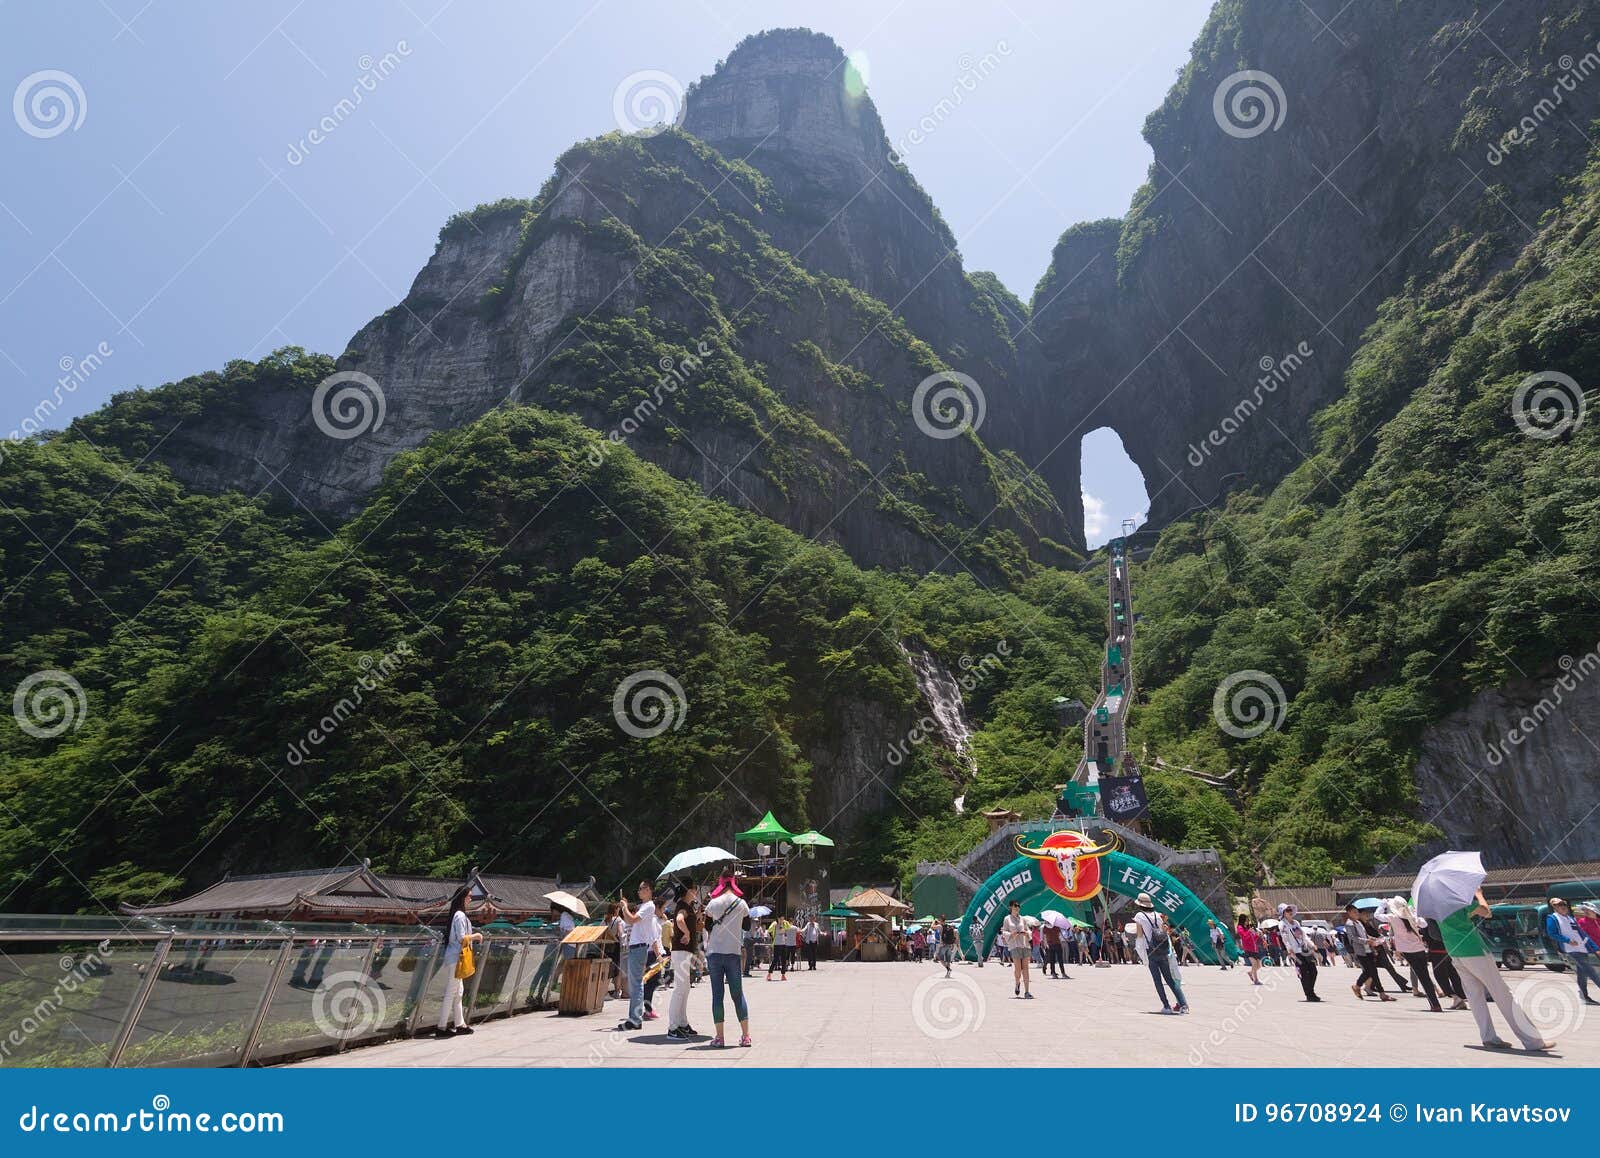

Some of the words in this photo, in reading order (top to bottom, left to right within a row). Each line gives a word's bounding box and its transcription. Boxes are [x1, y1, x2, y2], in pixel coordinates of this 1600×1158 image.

[974, 869, 1032, 928] Carabao
[1118, 866, 1184, 913] 卡拉宝
